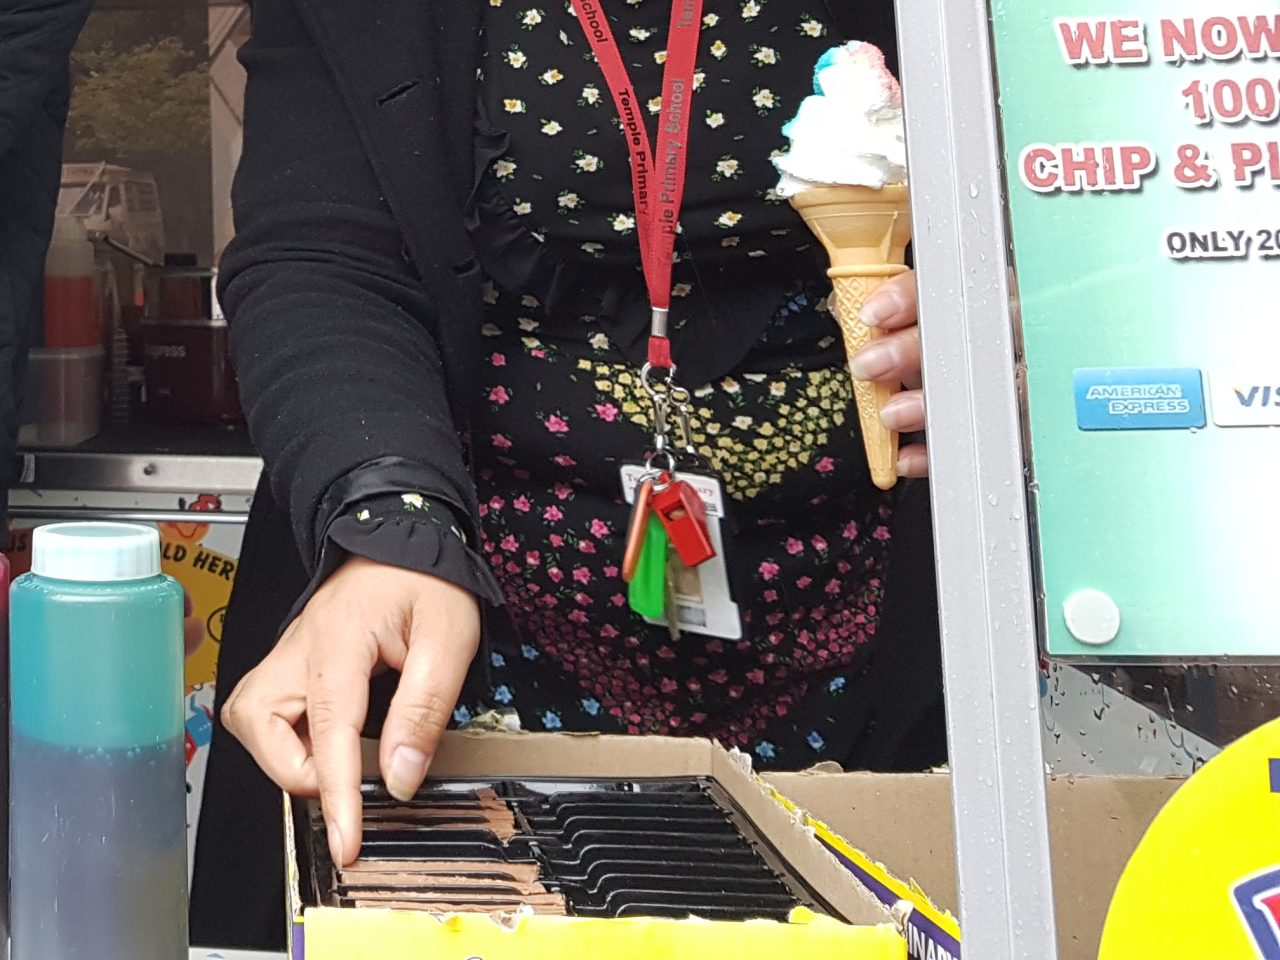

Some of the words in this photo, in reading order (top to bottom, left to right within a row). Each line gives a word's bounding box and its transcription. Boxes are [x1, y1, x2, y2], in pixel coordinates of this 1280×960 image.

[1059, 20, 1143, 60] WE
[1160, 14, 1280, 57] NOW
[665, 79, 684, 134] School
[1182, 78, 1280, 120] 100
[618, 88, 641, 146] Temple
[636, 151, 649, 216] Primary
[660, 139, 682, 204] Primary
[1023, 146, 1152, 188] CHIP
[1173, 143, 1212, 184] &
[1231, 141, 1280, 182] PI
[1167, 230, 1245, 253] ONLY
[1088, 385, 1181, 399] AMERICAN
[1111, 401, 1188, 413] EXPRESS
[163, 542, 187, 562] LD
[193, 551, 234, 581] HER
